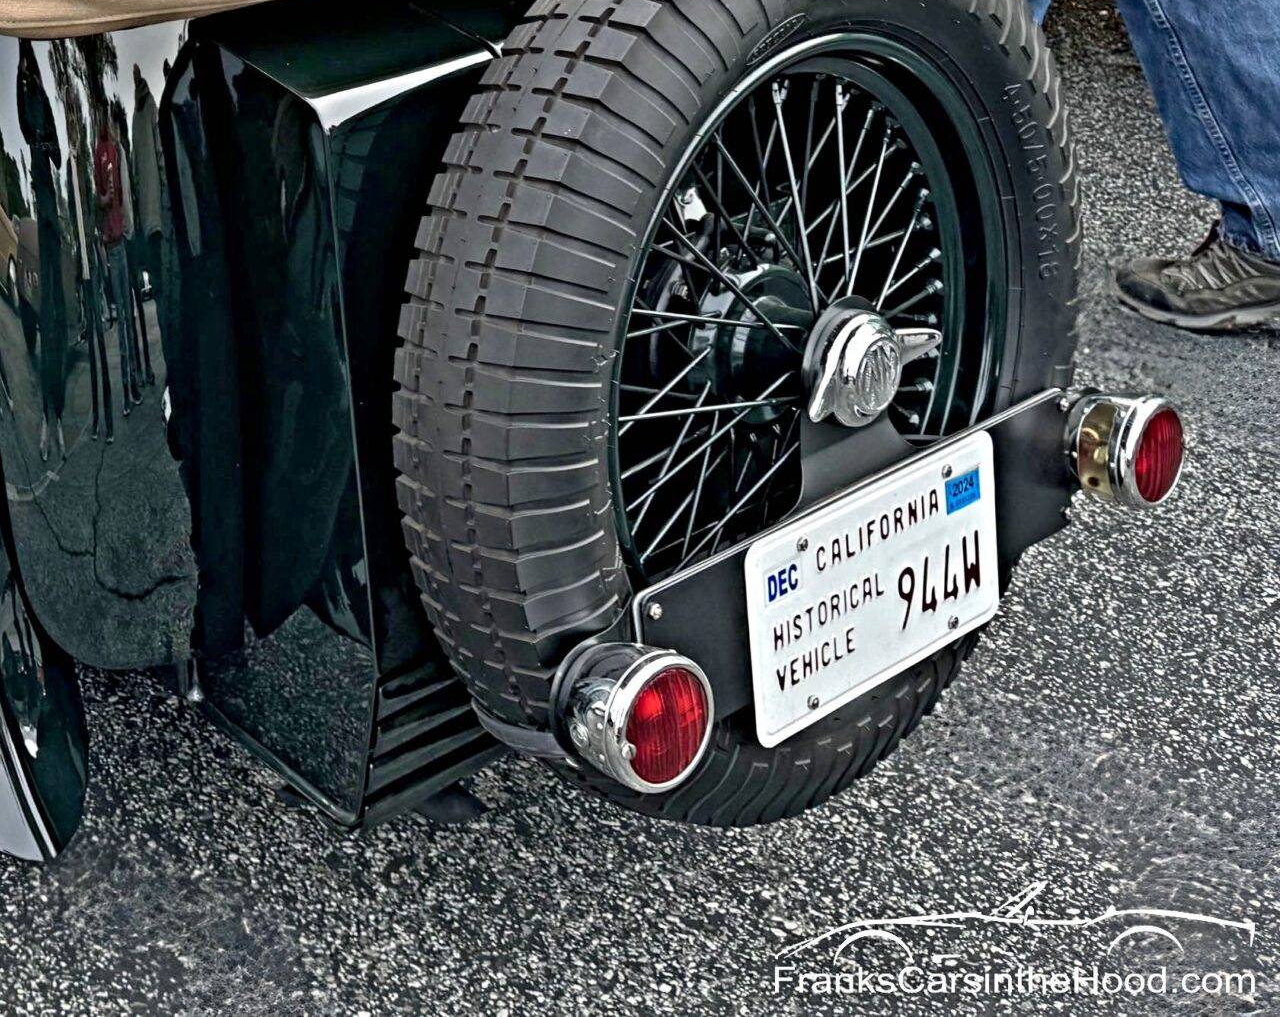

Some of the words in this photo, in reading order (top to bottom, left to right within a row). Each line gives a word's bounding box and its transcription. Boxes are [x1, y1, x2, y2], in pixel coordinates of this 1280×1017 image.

[951, 475, 975, 497] 2024
[815, 488, 940, 572] CALIFORNIA
[767, 563, 799, 603] DEC
[773, 573, 885, 652] HISTORICAL
[897, 529, 981, 631] 944W
[776, 627, 856, 692] VEHICLE
